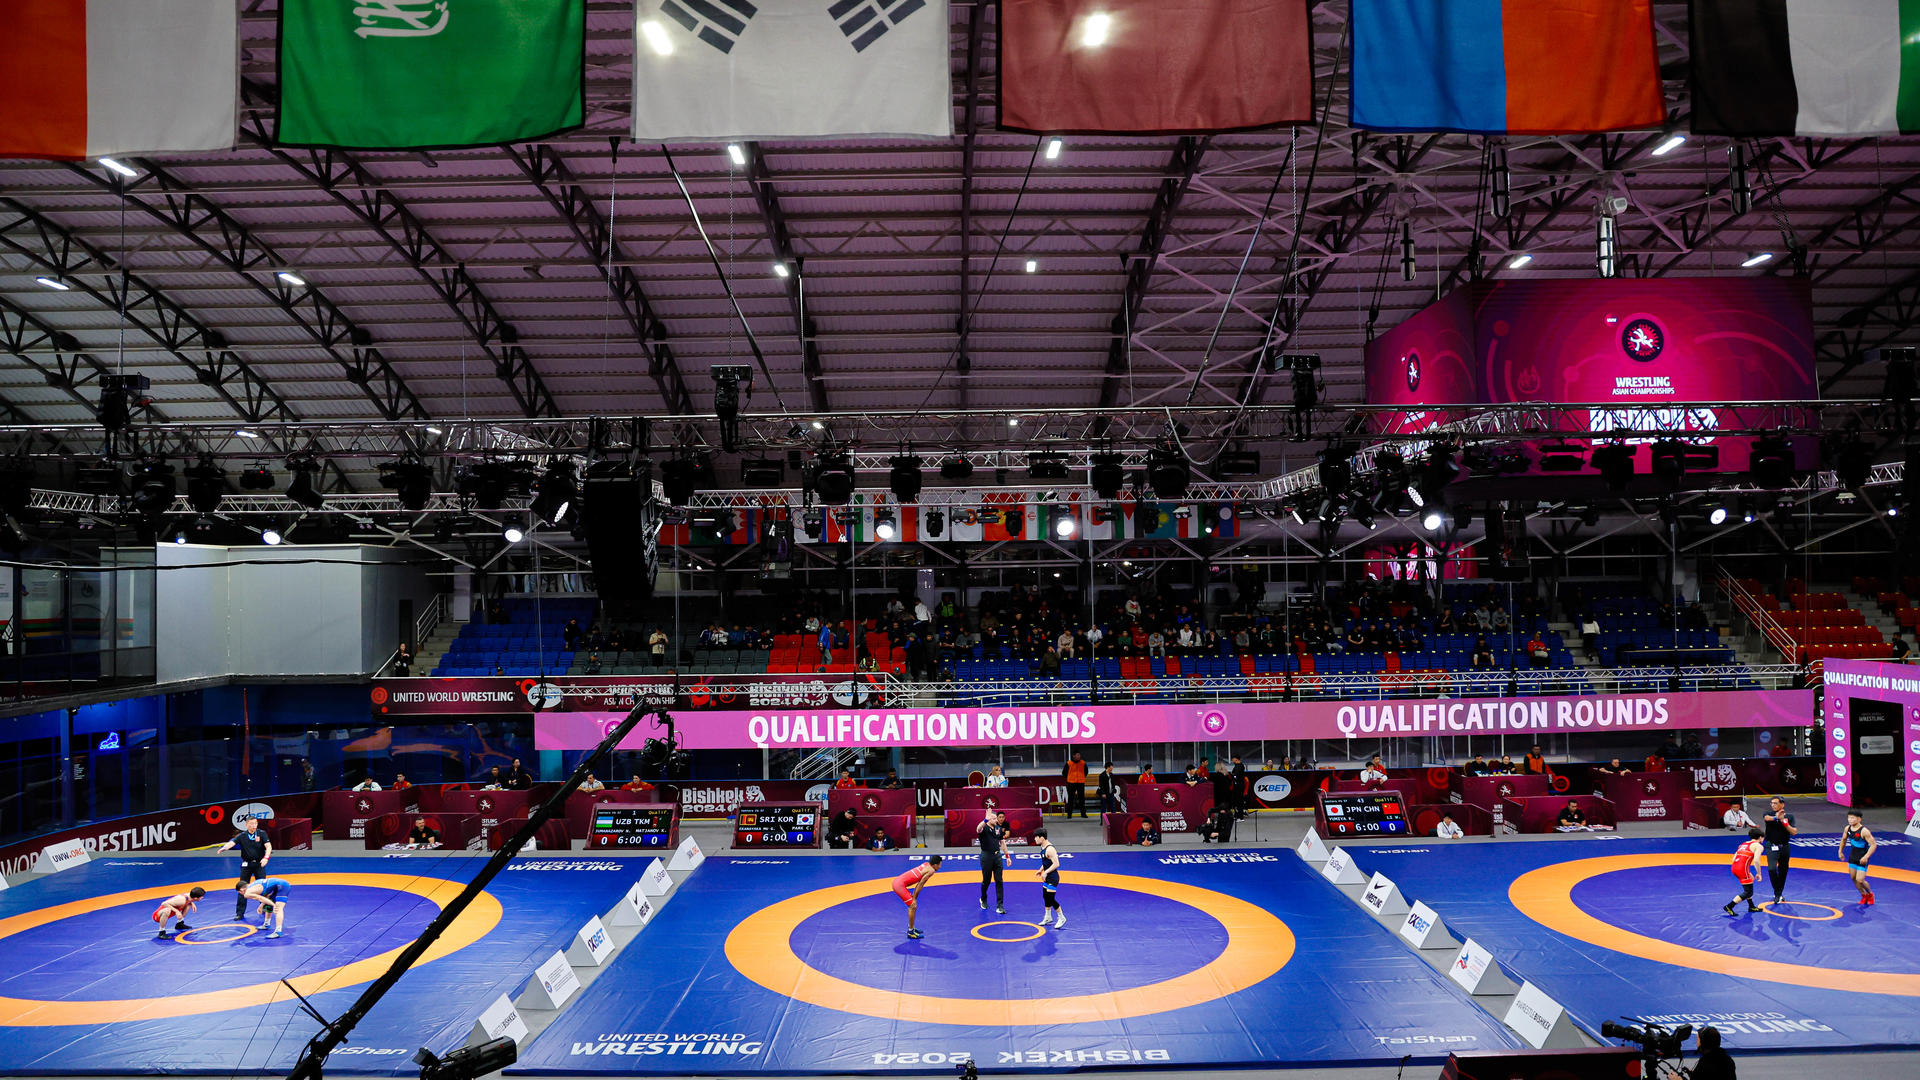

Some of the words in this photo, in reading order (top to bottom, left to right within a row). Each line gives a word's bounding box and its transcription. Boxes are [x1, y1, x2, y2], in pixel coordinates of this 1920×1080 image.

[1616, 376, 1670, 388] WRESTLING
[1630, 387, 1675, 395] CHAMPIONSHIPS
[1823, 671, 1889, 690] QUALIFICATION
[1891, 678, 1920, 693] ROUN
[393, 692, 425, 702] UNITED
[426, 692, 460, 702] WORLD
[461, 691, 514, 702] WRESTLING
[749, 698, 791, 706] 2024
[1336, 702, 1548, 738] QUALIFICATION
[1557, 698, 1668, 727] ROUNDS
[748, 712, 968, 748] QUALIFICATION
[977, 711, 1096, 739] ROUNDS
[1257, 784, 1288, 792] 1XBET
[682, 787, 745, 804] Bishkek
[682, 804, 726, 813] 2024
[1339, 824, 1346, 832] 0
[1355, 823, 1379, 831] 6:00
[1389, 823, 1396, 831] 0
[82, 821, 177, 851] RESTLING
[601, 836, 608, 845] 0
[618, 836, 642, 844] 6:00
[651, 836, 657, 845] 0
[746, 834, 753, 842] 0
[763, 834, 787, 842] 6:00
[797, 834, 803, 842] 0
[52, 848, 85, 863] UWW.ORG
[1158, 856, 1278, 865] WRESTLING
[1407, 913, 1431, 934] 1XBET
[587, 927, 606, 952] 1XBET
[1637, 1013, 1711, 1023] UNITED
[1709, 1012, 1786, 1022] WORLD
[598, 1033, 670, 1041] UNITED
[674, 1033, 746, 1041] WORLD
[1374, 1034, 1478, 1045] TaiShan
[570, 1042, 762, 1056] WRESTLING
[872, 1052, 971, 1064] 2024
[998, 1049, 1170, 1063] BISHKEK
